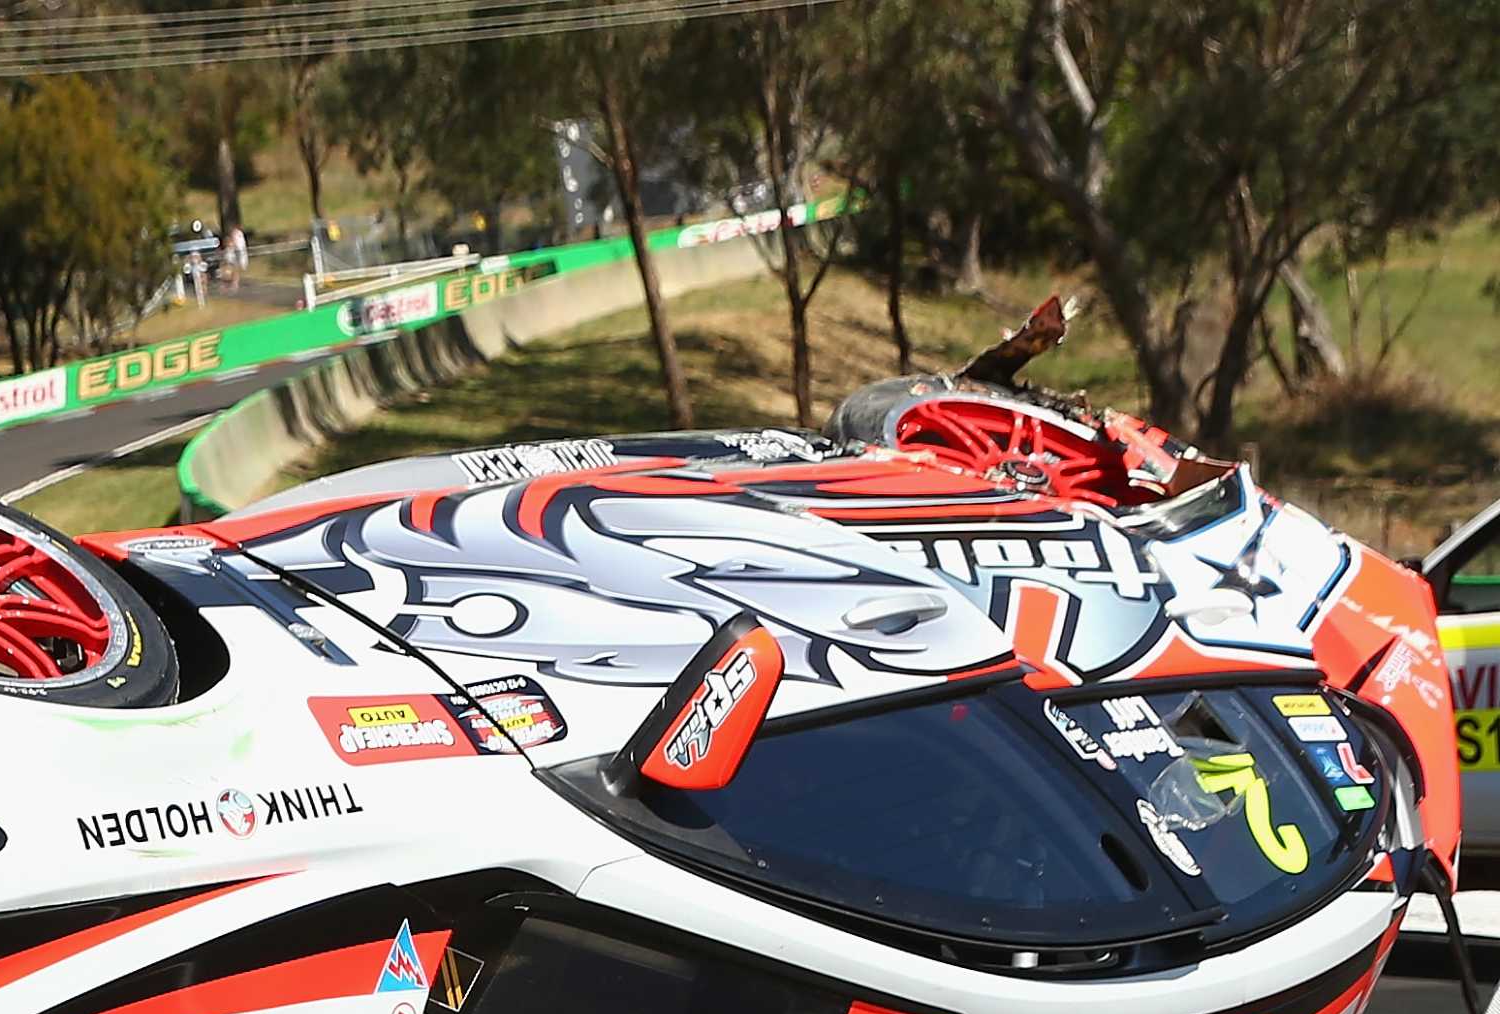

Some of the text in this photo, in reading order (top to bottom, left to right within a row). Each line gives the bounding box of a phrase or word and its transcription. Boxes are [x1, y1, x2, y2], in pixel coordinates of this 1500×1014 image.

[77, 333, 222, 400] EDGE
[339, 719, 455, 753] SUPERCHEAP
[360, 709, 407, 723] AUTO
[76, 782, 364, 851] THINK HOLDEN
